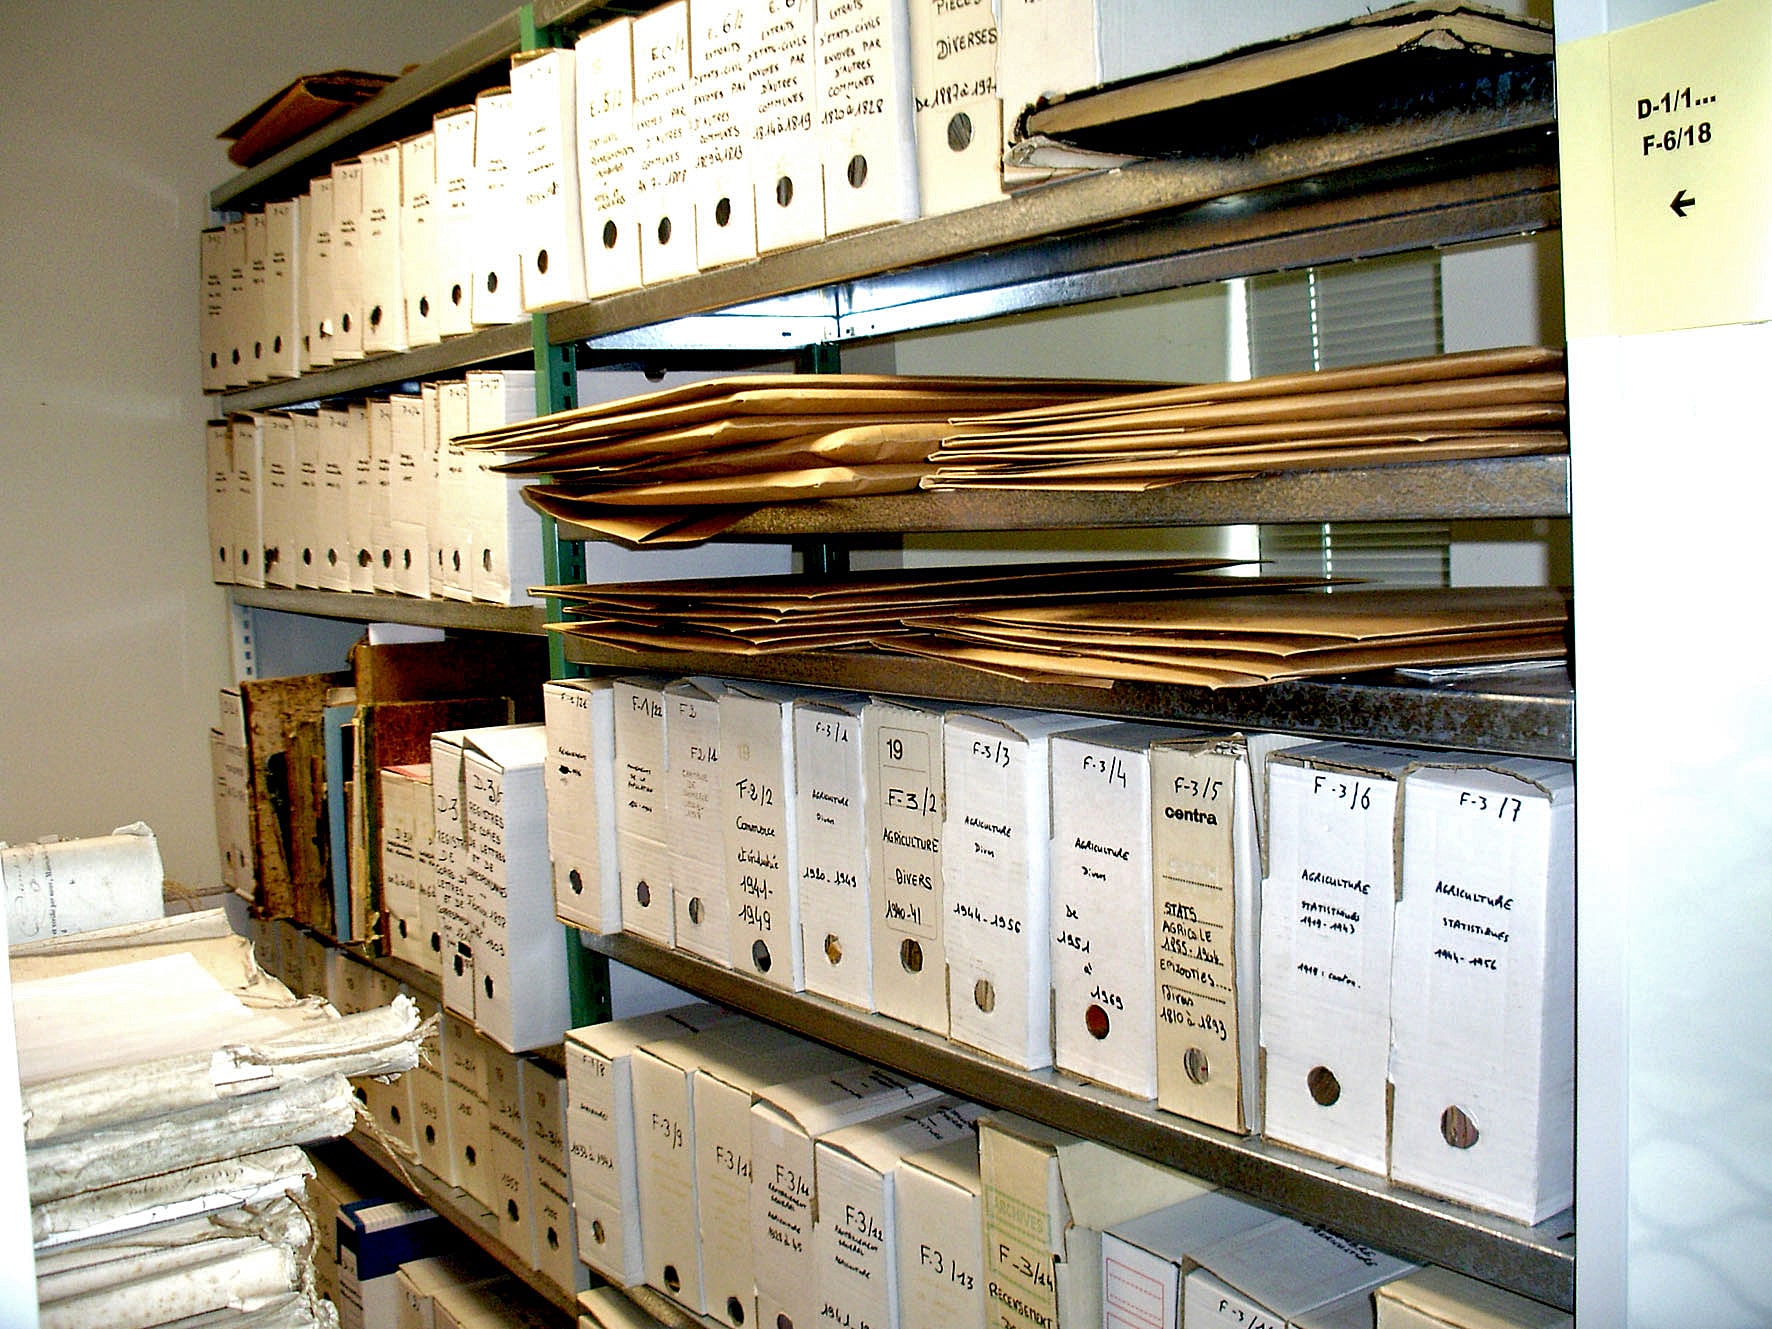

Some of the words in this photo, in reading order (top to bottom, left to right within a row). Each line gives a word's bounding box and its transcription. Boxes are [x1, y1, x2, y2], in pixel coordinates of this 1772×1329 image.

[1643, 122, 1712, 156] F-6/18
[886, 738, 904, 760] 19
[973, 741, 1010, 768] F-3/3
[888, 786, 937, 816] F-3/2
[1174, 777, 1223, 800] F-3/5
[1314, 776, 1371, 810] F-3/6
[1164, 806, 1218, 826] centra
[1459, 791, 1522, 822] F-3/7
[964, 815, 1012, 838] AGRICULTURE
[883, 827, 940, 853] AGRICULTURE
[1075, 837, 1130, 861] AGRICULTURE
[1301, 869, 1371, 895] AGRICULTURE
[1434, 881, 1514, 911] AGRICULTURE
[738, 904, 771, 931] 1949
[1065, 904, 1079, 920] De
[1163, 901, 1198, 923] STATS
[989, 1282, 1053, 1329] RECENSEMENT
